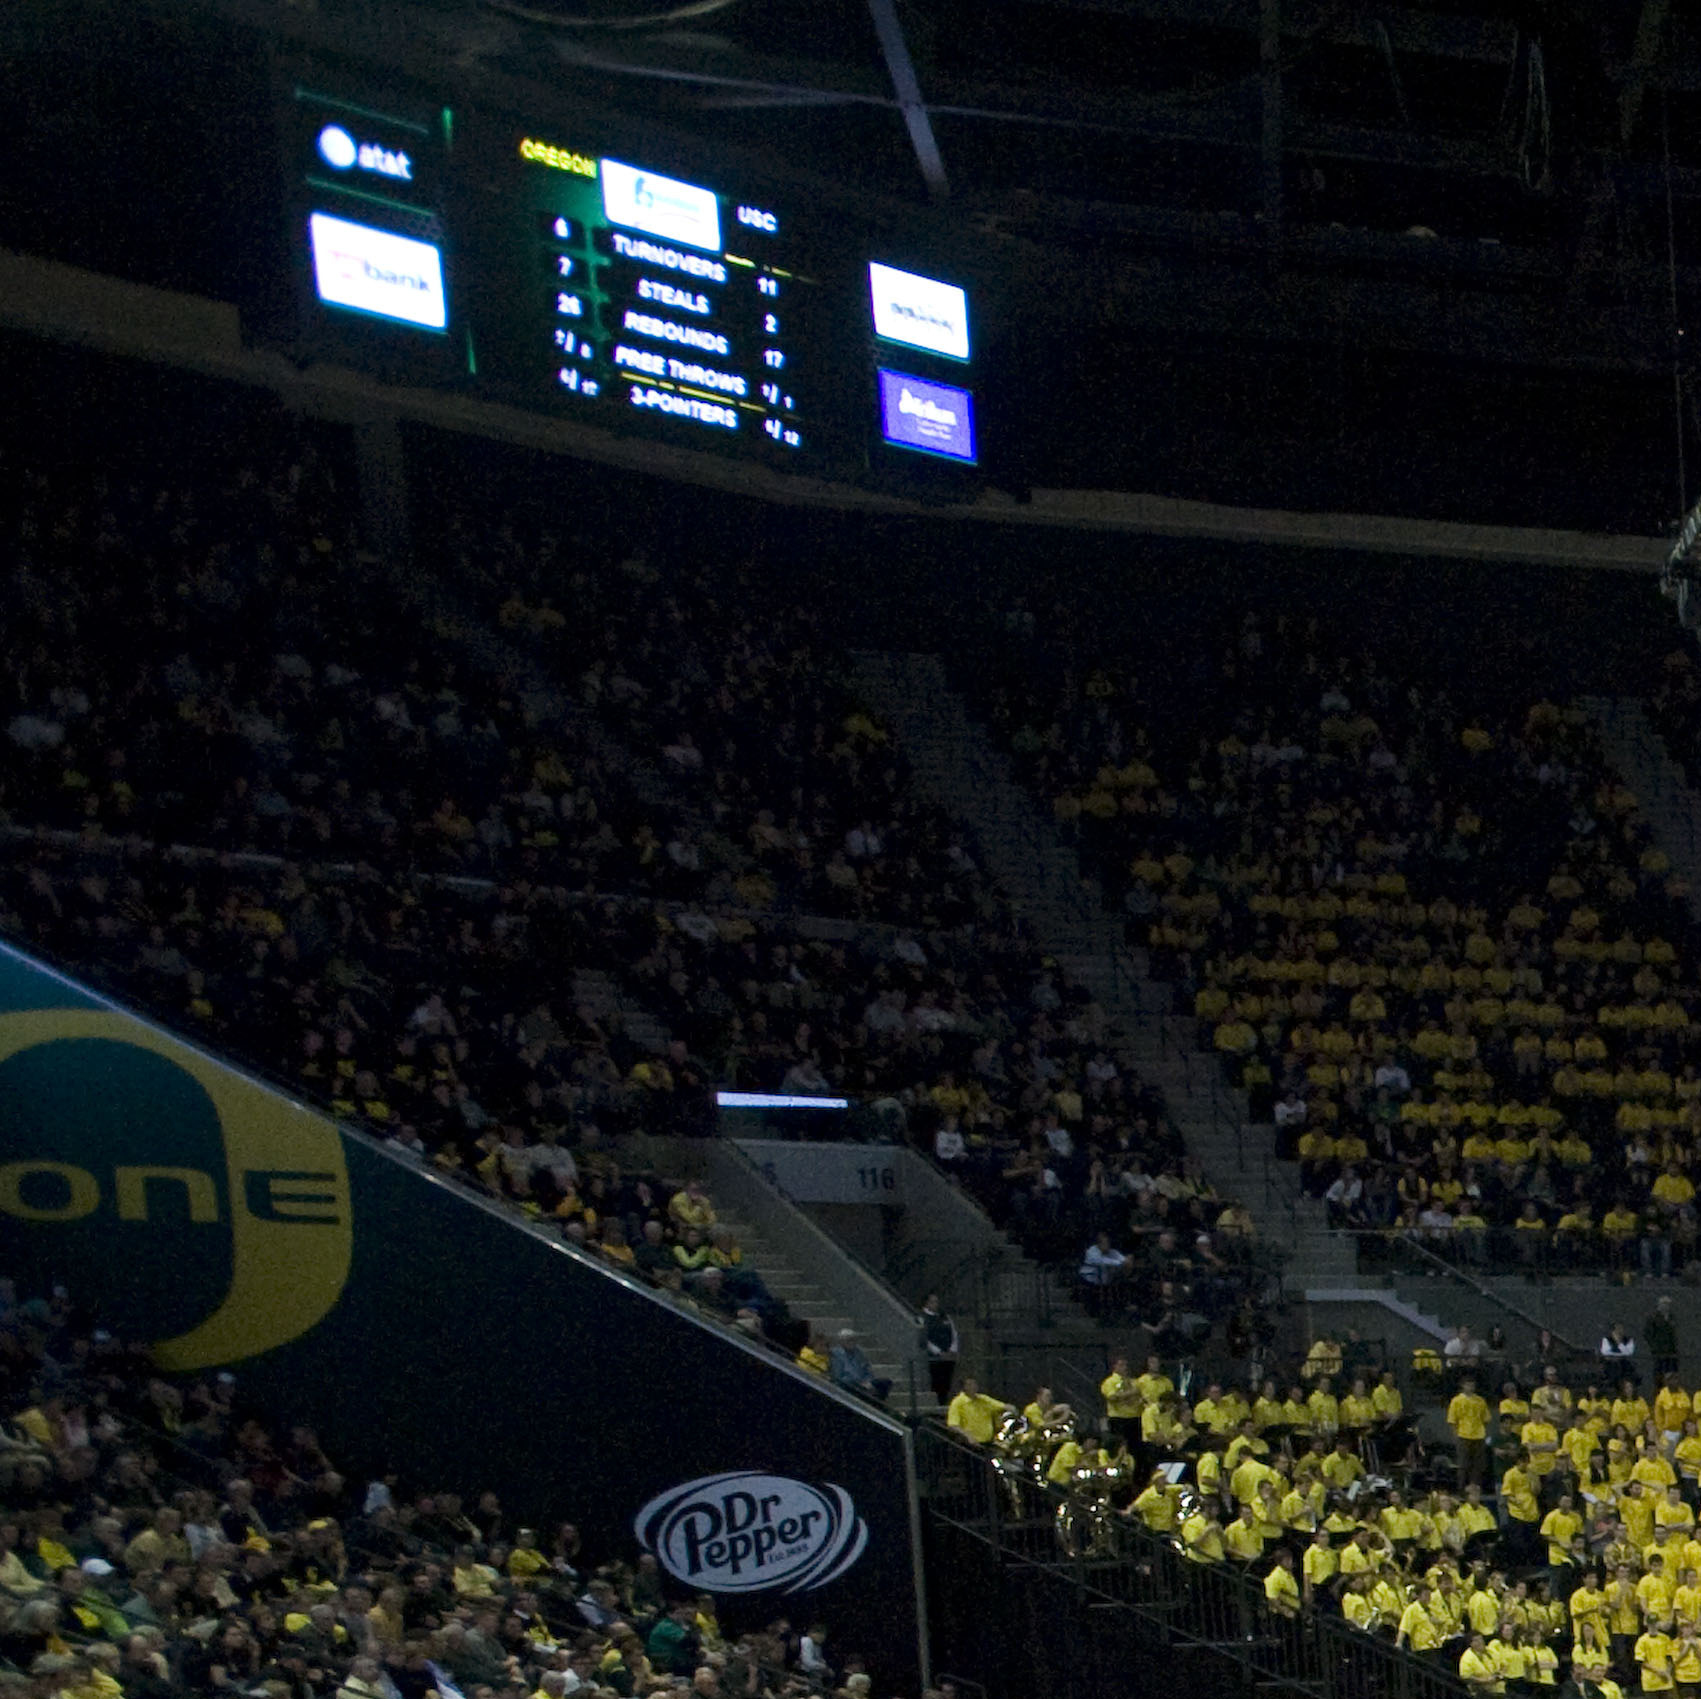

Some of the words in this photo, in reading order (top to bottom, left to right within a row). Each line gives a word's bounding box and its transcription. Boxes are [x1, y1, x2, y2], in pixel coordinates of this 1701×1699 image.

[520, 137, 597, 179] OREGON
[738, 205, 778, 233] USC
[612, 232, 728, 284] TURNOVERS
[638, 278, 711, 315] STEALS
[622, 310, 730, 356] REBOUNDS
[613, 345, 666, 376] FREE
[667, 357, 747, 397] THROWS
[630, 385, 739, 430] 3-POINTERS
[721, 1491, 783, 1535] Dr
[682, 1501, 822, 1577] Pepper
